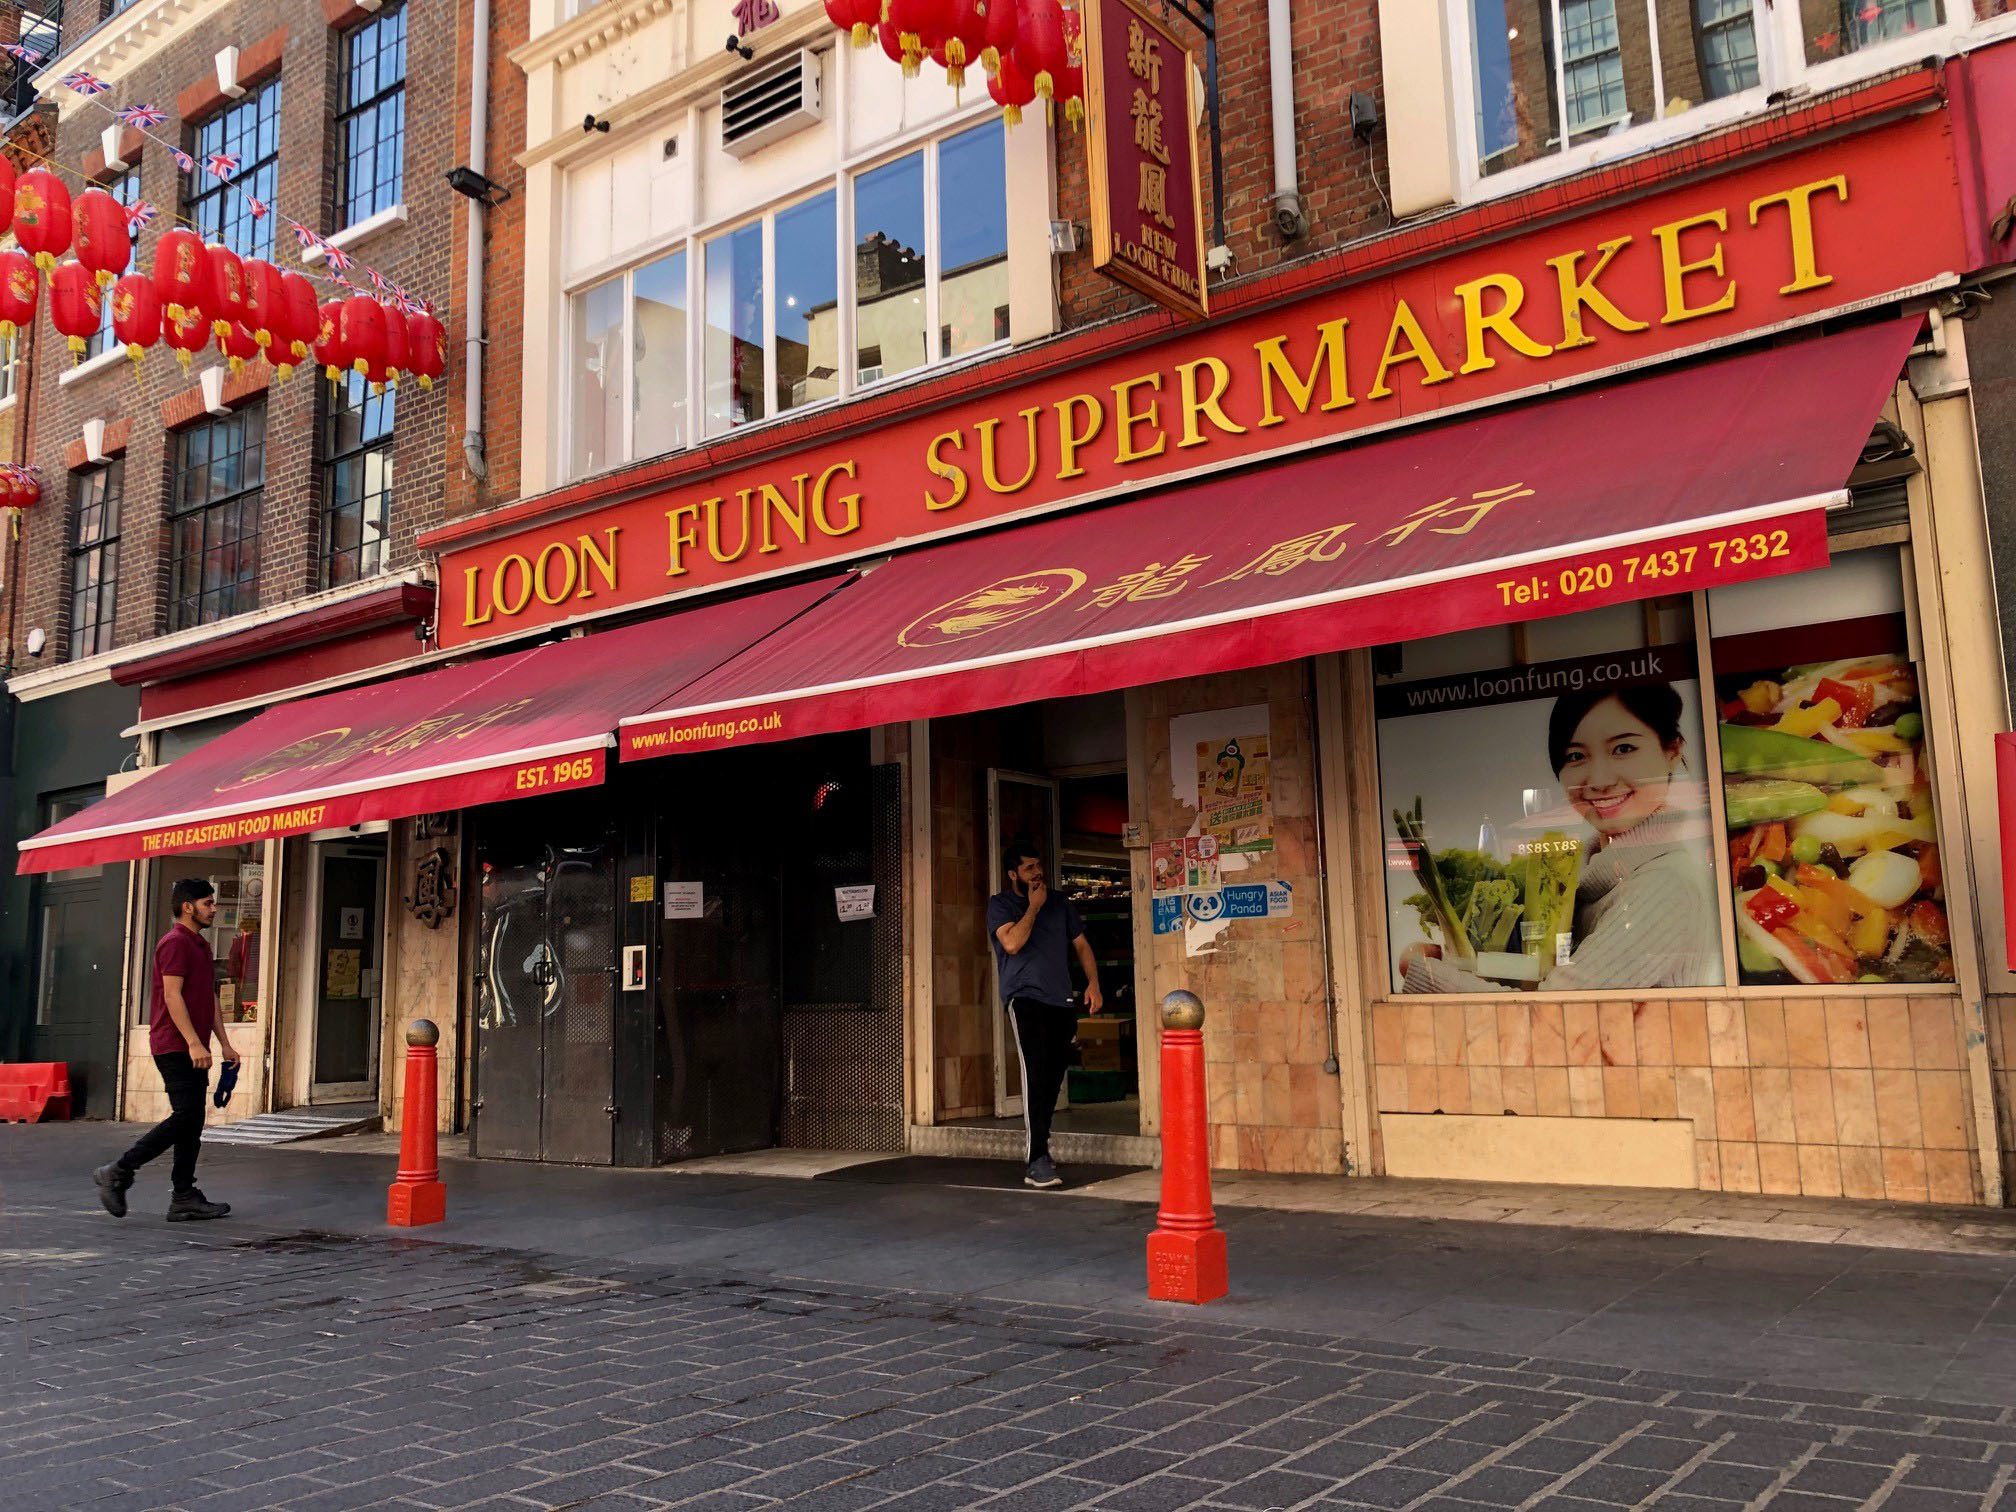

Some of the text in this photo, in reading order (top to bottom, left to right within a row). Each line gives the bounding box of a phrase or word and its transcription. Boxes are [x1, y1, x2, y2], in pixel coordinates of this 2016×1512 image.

[1140, 223, 1178, 261] NEW
[1114, 231, 1201, 299] LOON FUNG
[463, 174, 1848, 628] LOON FUNG SUPERMARKET
[1497, 530, 1791, 611] Tel: 020 7437 7332
[1407, 652, 1663, 706] www.loonfung.co.uk
[631, 711, 782, 750] www.loonfung.co.uk
[516, 757, 594, 791] EST. 1965
[142, 805, 326, 852] THE FAR EASTERN FOOD MARKET
[1226, 890, 1264, 902] Hungry
[1230, 903, 1263, 914] Panda
